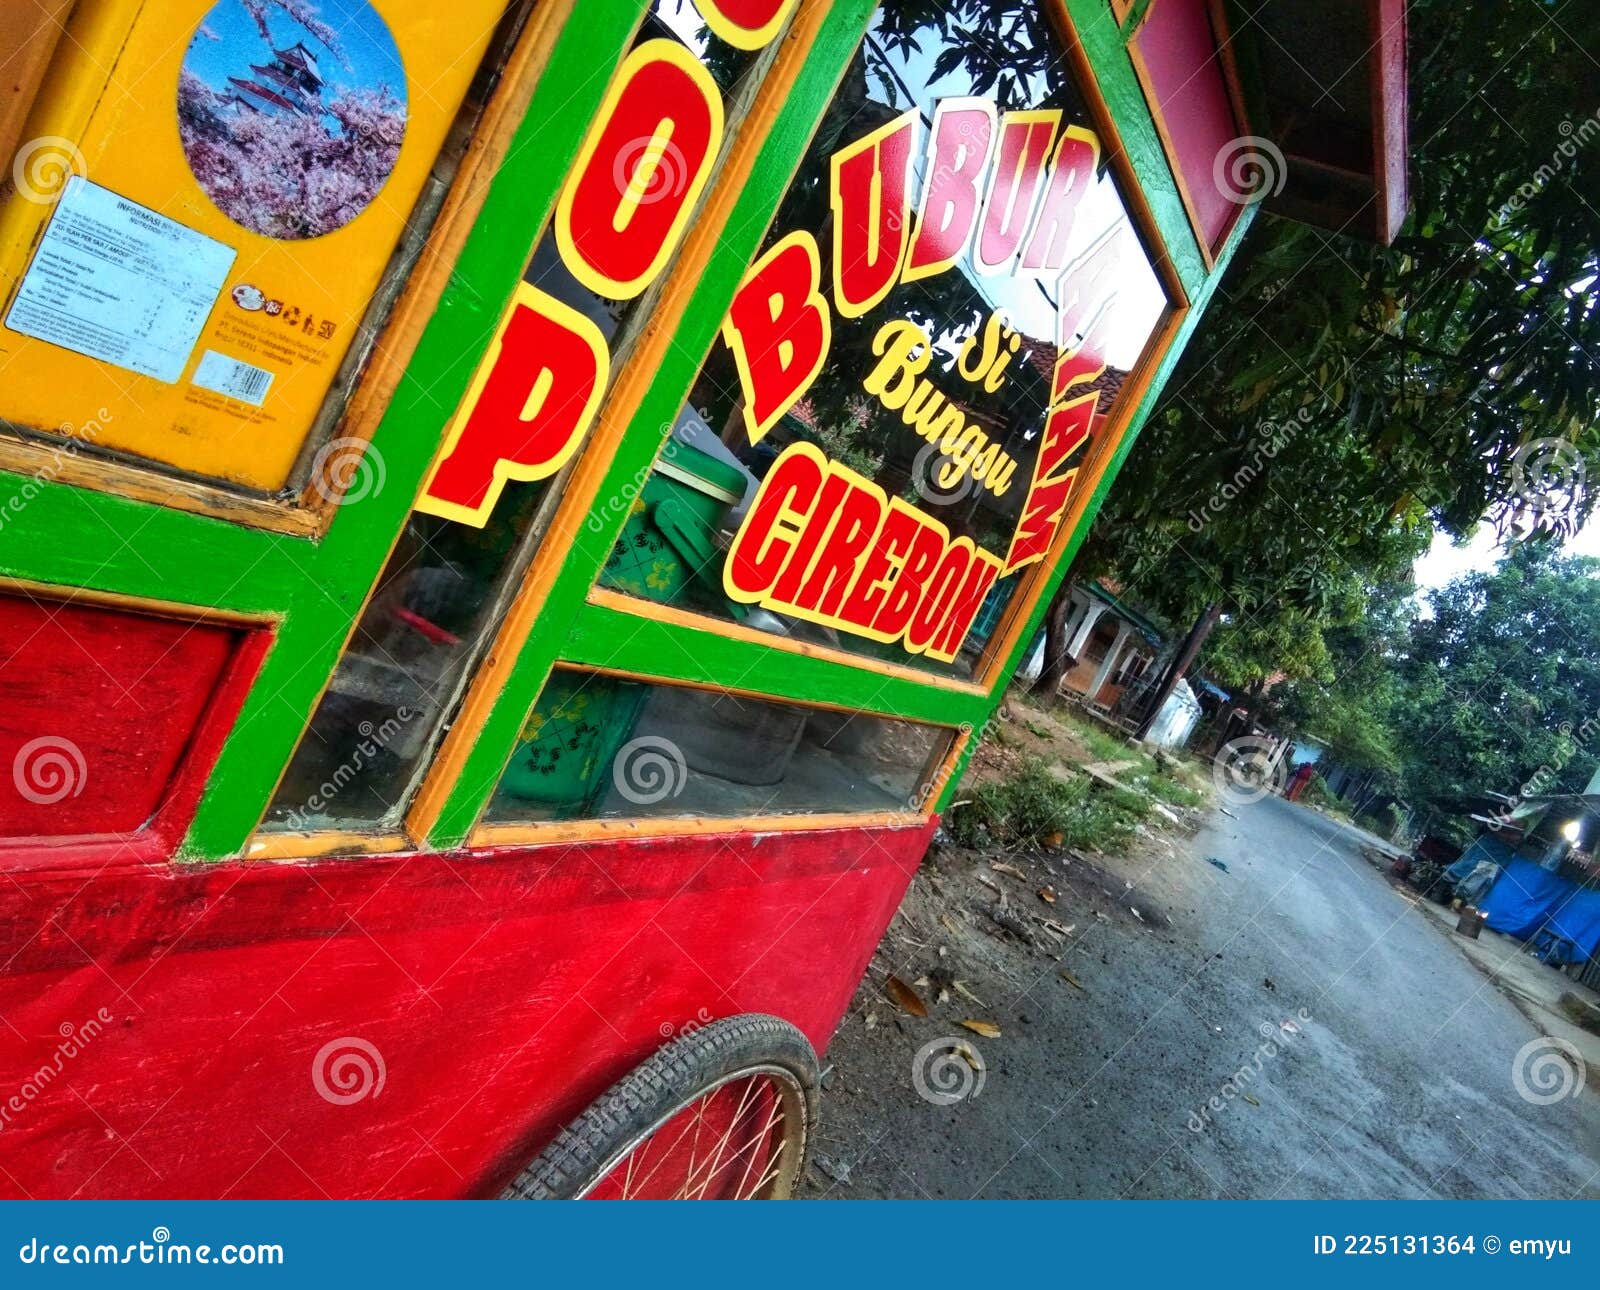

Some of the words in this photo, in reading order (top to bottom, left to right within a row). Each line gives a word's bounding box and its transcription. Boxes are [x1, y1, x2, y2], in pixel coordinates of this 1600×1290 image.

[722, 96, 1101, 447] BUBUR
[957, 307, 1022, 393] Si
[862, 319, 1019, 497] Bungsu
[722, 441, 1003, 663] CIREBON
